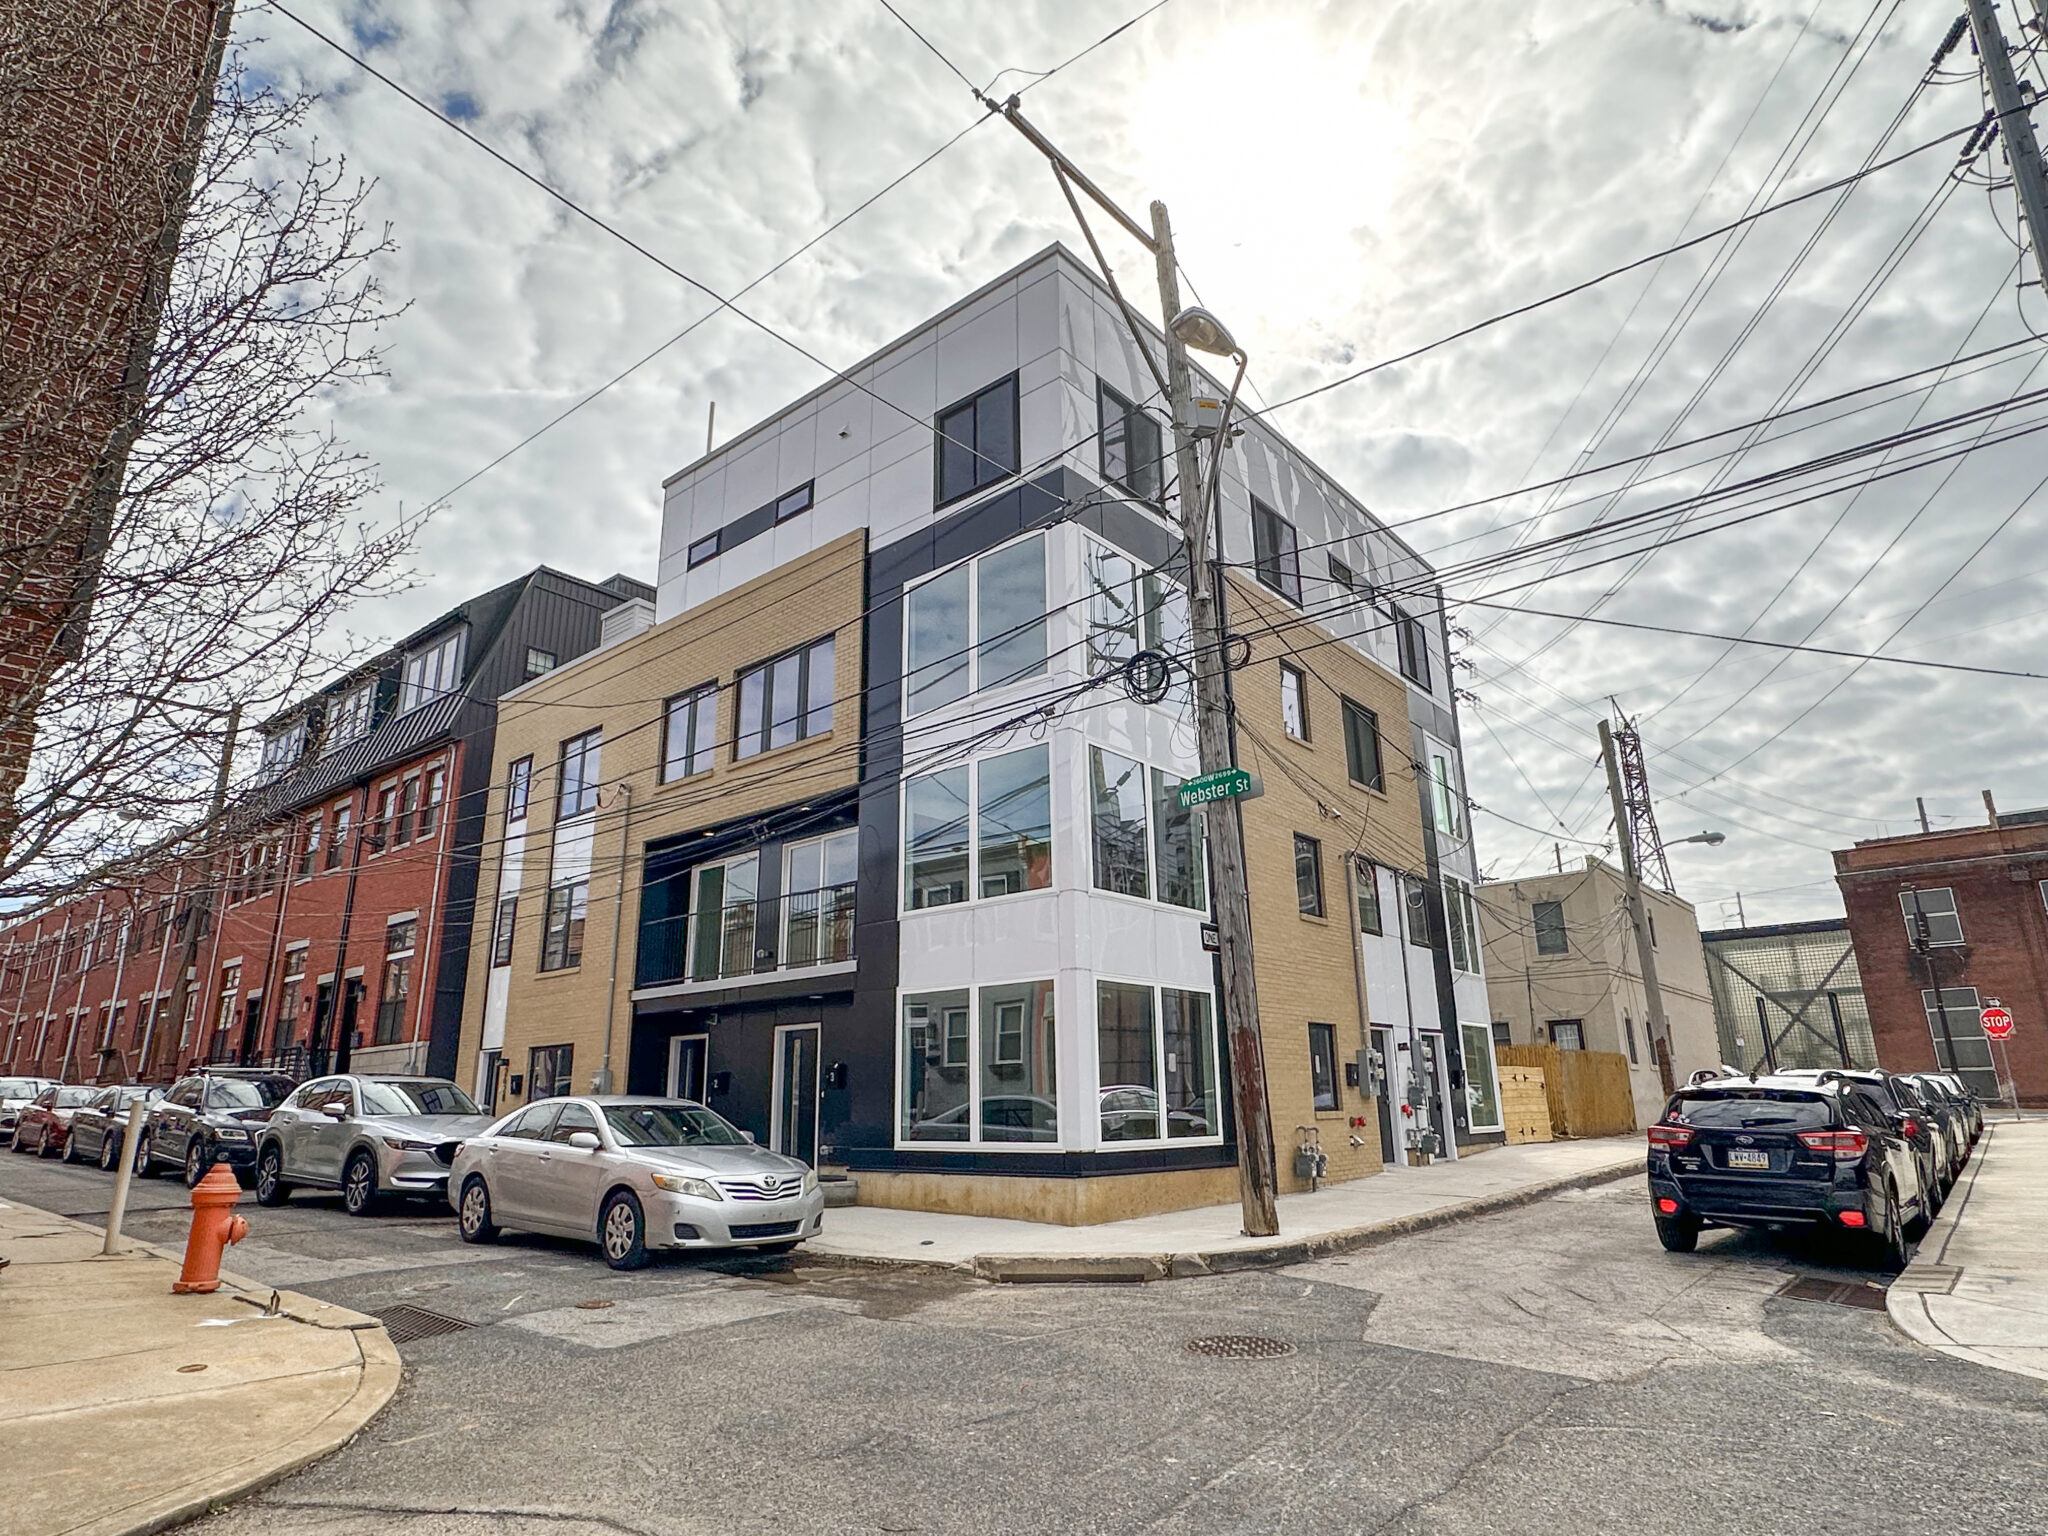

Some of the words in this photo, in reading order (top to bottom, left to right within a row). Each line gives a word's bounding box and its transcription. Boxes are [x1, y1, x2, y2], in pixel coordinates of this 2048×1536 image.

[1207, 774, 1215, 782] W
[1180, 782, 1231, 807] Webster
[1236, 778, 1249, 792] St
[1982, 1016, 2010, 1027] STOP
